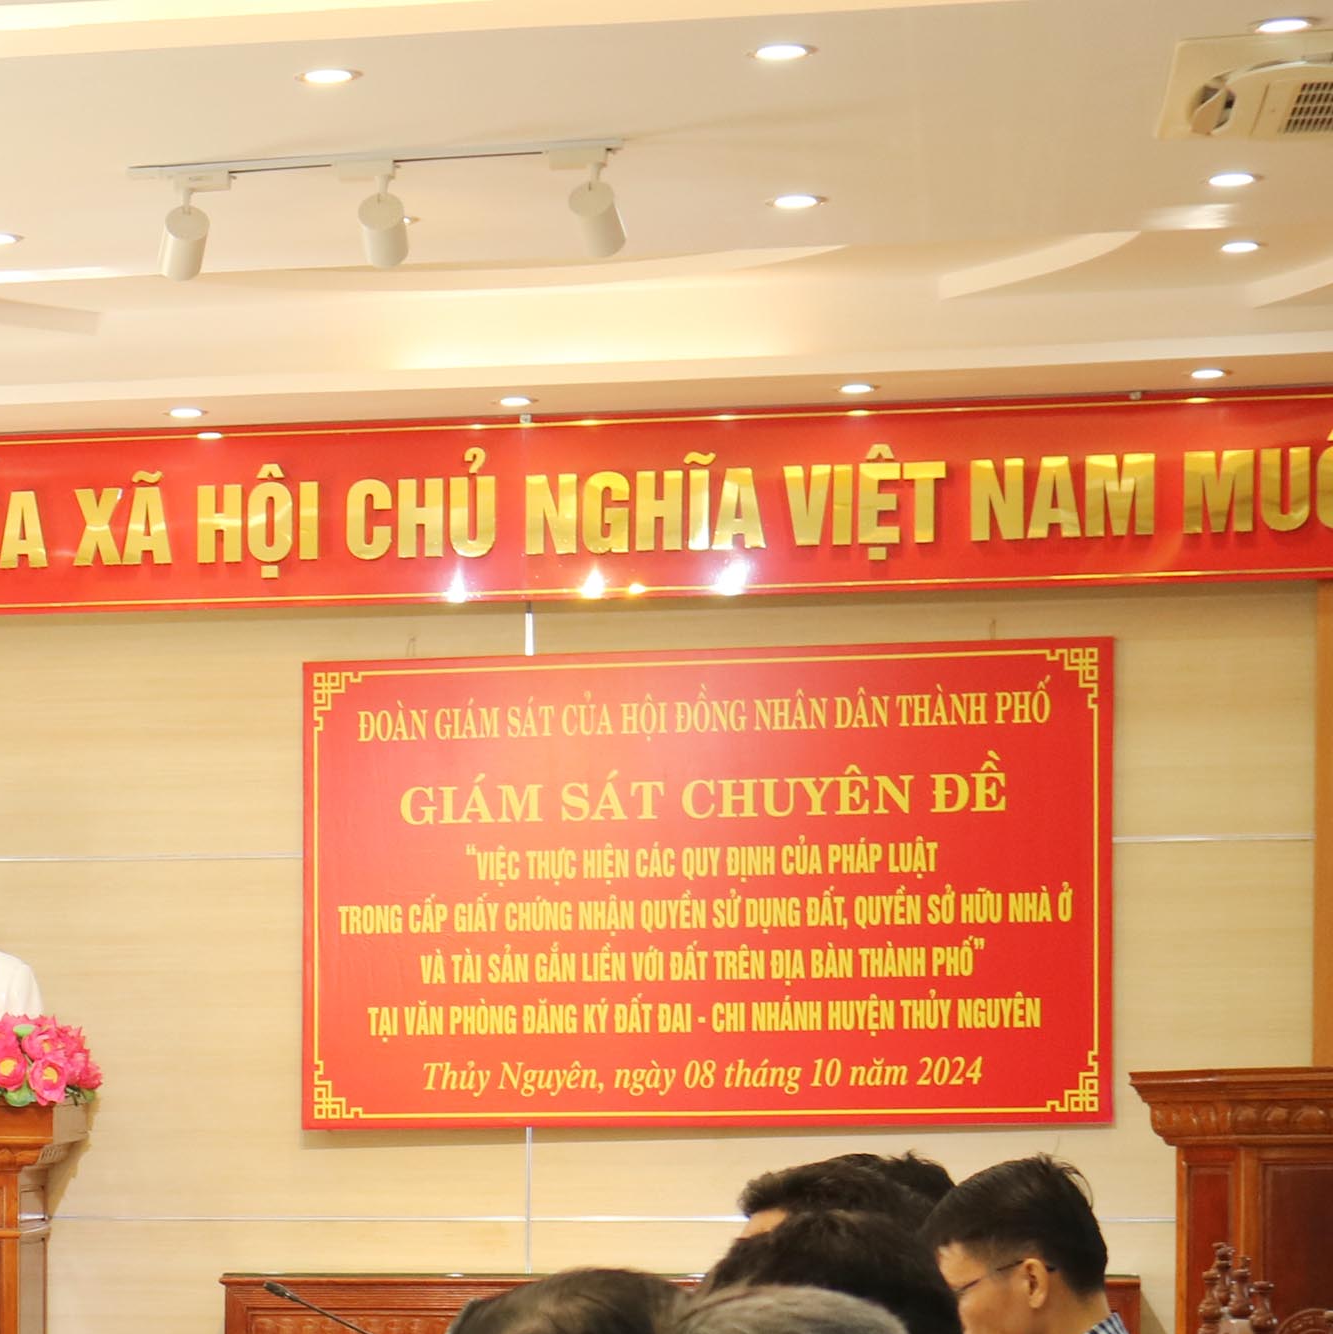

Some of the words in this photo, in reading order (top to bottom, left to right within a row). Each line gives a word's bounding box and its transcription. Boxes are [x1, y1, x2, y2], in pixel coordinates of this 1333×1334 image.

[73, 469, 172, 568] XÃ
[197, 463, 318, 579] HỘI
[344, 447, 497, 561] CHỦ
[525, 451, 767, 556] NGHĨA
[782, 444, 947, 561] VIỆT
[969, 452, 1156, 541] NAM
[357, 701, 428, 742] ĐOÀN
[435, 698, 499, 740] GIÁM
[507, 697, 555, 738] SÁT
[561, 692, 610, 737] CỦA
[621, 693, 668, 742] HỘI
[674, 684, 746, 734] ĐỒNG
[754, 689, 828, 731] NHÂN
[834, 687, 888, 729] DÂN
[896, 684, 988, 727] THÀNH
[995, 675, 1052, 723] PHỐ
[399, 773, 544, 825] GIÁM
[561, 769, 665, 822] SÁT
[681, 764, 915, 819] CHUYÊN
[930, 749, 1007, 813] ĐỀ
[526, 850, 577, 885] THỰC
[583, 843, 630, 885] HIỆN
[635, 841, 676, 878] CÁC
[682, 847, 720, 878] QUY
[726, 845, 775, 882] ĐỊNH
[781, 835, 823, 875] CỦA
[828, 838, 883, 875] PHÁP
[888, 836, 939, 880] LUẬT
[338, 904, 403, 935] TRONG
[408, 894, 448, 934] CẤP
[453, 892, 499, 933] GIẤY
[504, 895, 573, 932] CHỨNG
[578, 894, 635, 936] NHẬN
[640, 888, 707, 931] QUYỀN
[712, 888, 742, 928] SỬ
[746, 897, 801, 934] DỤNG
[806, 885, 848, 930] ĐẤT,
[853, 885, 922, 928] QUYỀN
[927, 884, 956, 924] SỞ
[960, 887, 1005, 924] HỮU
[1009, 885, 1053, 923] NHÀ
[1057, 881, 1074, 922] Ở
[420, 946, 446, 985] VÀ
[451, 946, 482, 984] TÀI
[488, 943, 529, 983] SẢN
[534, 941, 577, 983] GẮN
[582, 940, 627, 982] LIỀN
[631, 943, 665, 982] VỚI
[669, 940, 708, 981] ĐẤT
[714, 945, 765, 981] TRÊN
[770, 948, 806, 985] ĐỊA
[811, 943, 853, 979] BÀN
[858, 941, 927, 978] THÀNH
[368, 1006, 399, 1043] TẠI
[404, 1000, 444, 1036] VĂN
[449, 998, 517, 1036] PHÒNG
[522, 998, 578, 1035] ĐĂNG
[582, 997, 608, 1034] KÝ
[614, 993, 653, 1034] ĐẤT
[657, 1003, 692, 1033] ĐAI
[711, 1001, 746, 1033] CHI
[751, 996, 823, 1032] NHÁNH
[828, 994, 896, 1037] HUYỆN
[900, 988, 952, 1030] THỦY
[958, 991, 1042, 1029] NGUYÊN
[423, 1060, 492, 1096] Thủy
[498, 1060, 605, 1096] Nguyên,
[614, 1060, 677, 1096] ngày
[683, 1060, 716, 1089] 08
[724, 1057, 802, 1094] tháng
[810, 1058, 842, 1087] 10
[848, 1057, 909, 1087] năm
[917, 1056, 984, 1085] 2024
